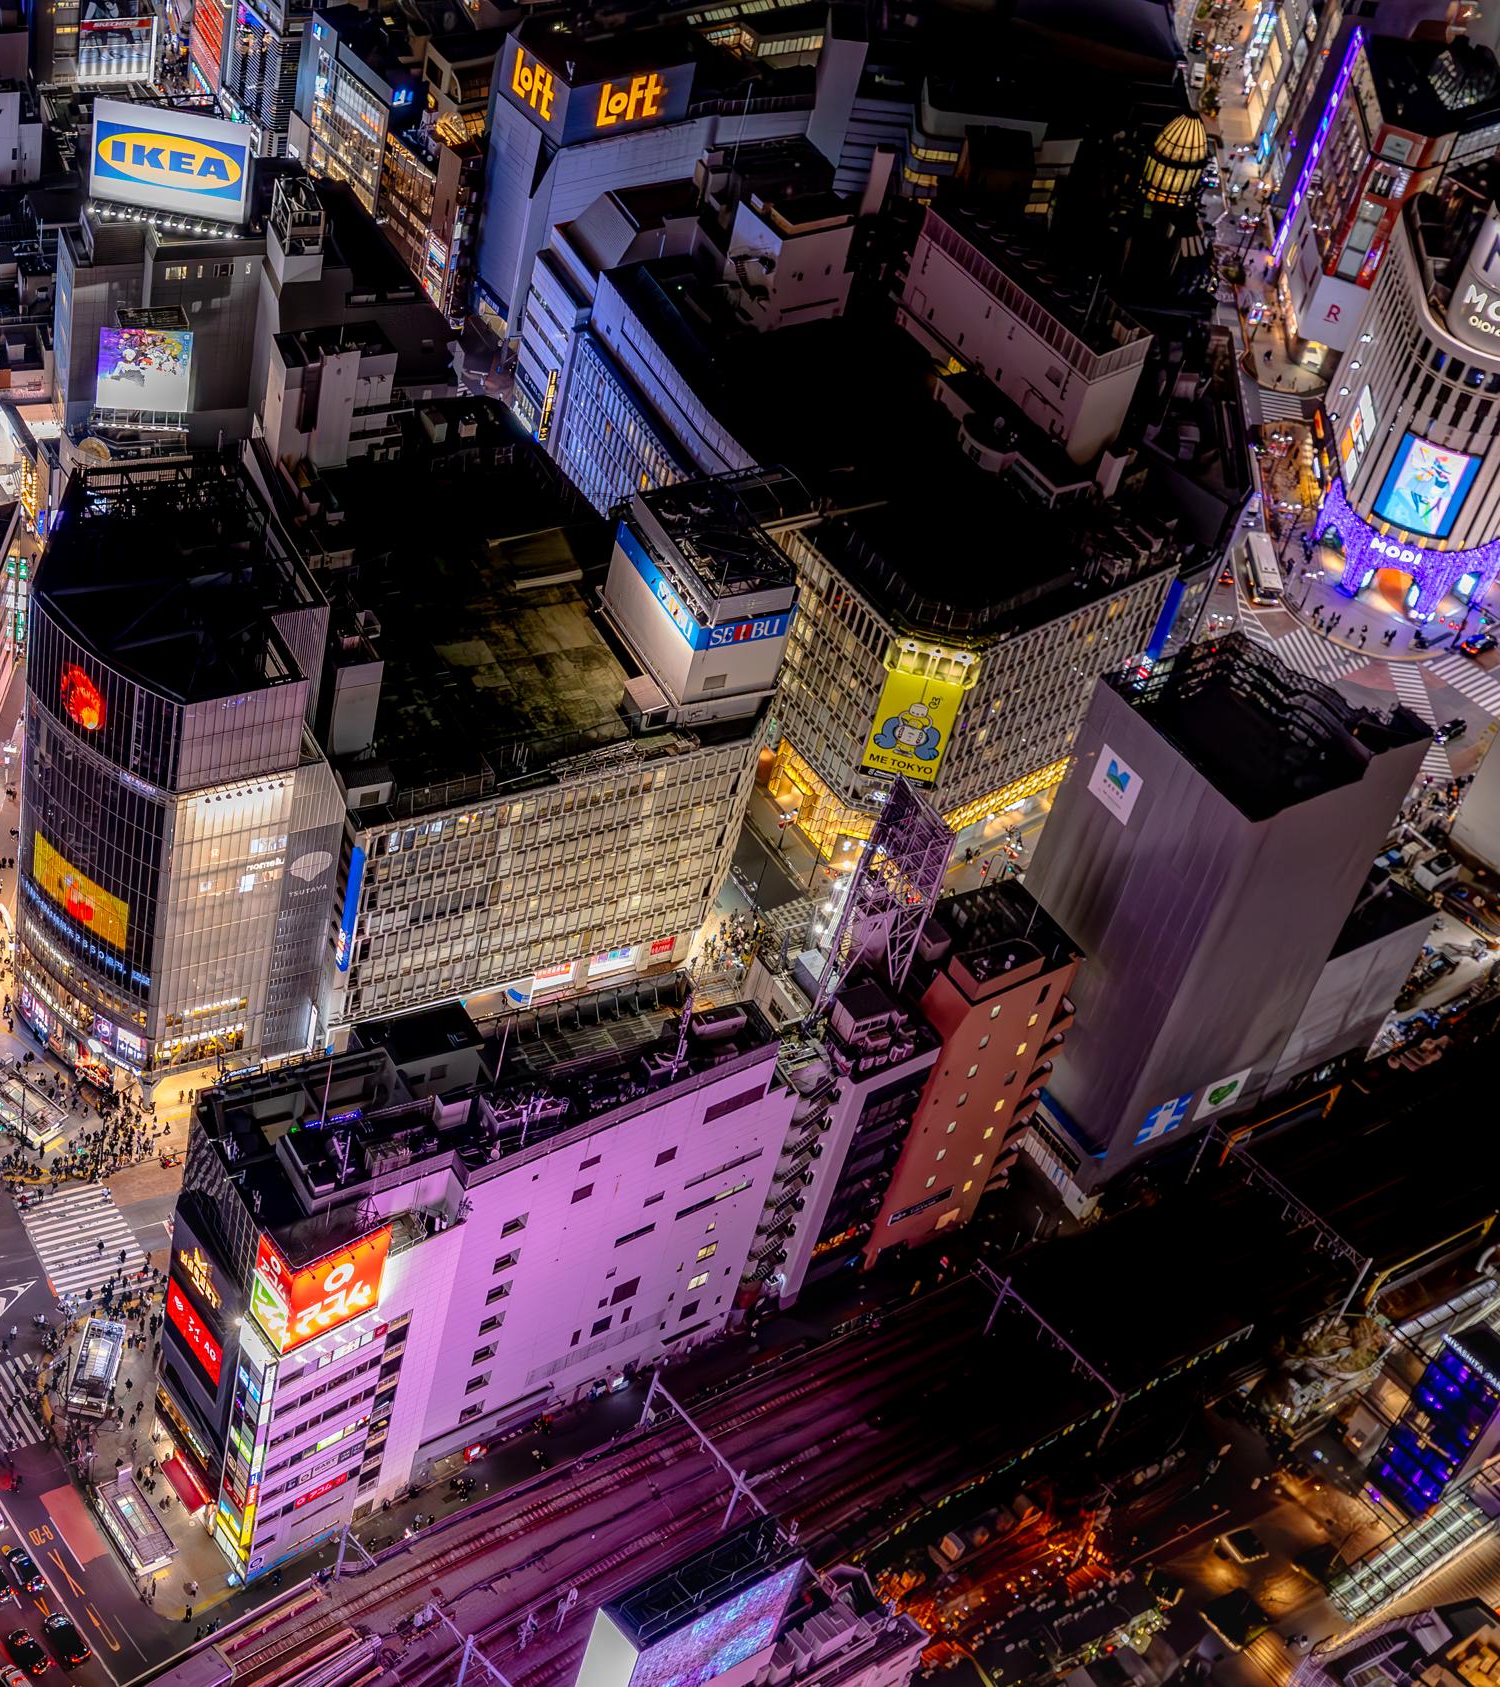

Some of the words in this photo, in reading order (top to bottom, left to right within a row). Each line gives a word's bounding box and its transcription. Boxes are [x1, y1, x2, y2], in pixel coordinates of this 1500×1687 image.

[93, 20, 139, 28] SKECHERS
[111, 140, 231, 182] IKEA
[1370, 537, 1423, 565] MODI
[710, 618, 781, 645] SEIBU
[869, 753, 888, 765] ME
[889, 758, 934, 775] TOKYO
[288, 883, 328, 897] TSUTAYA
[164, 1022, 243, 1049] STARBUCKS
[296, 1280, 372, 1333] アコム
